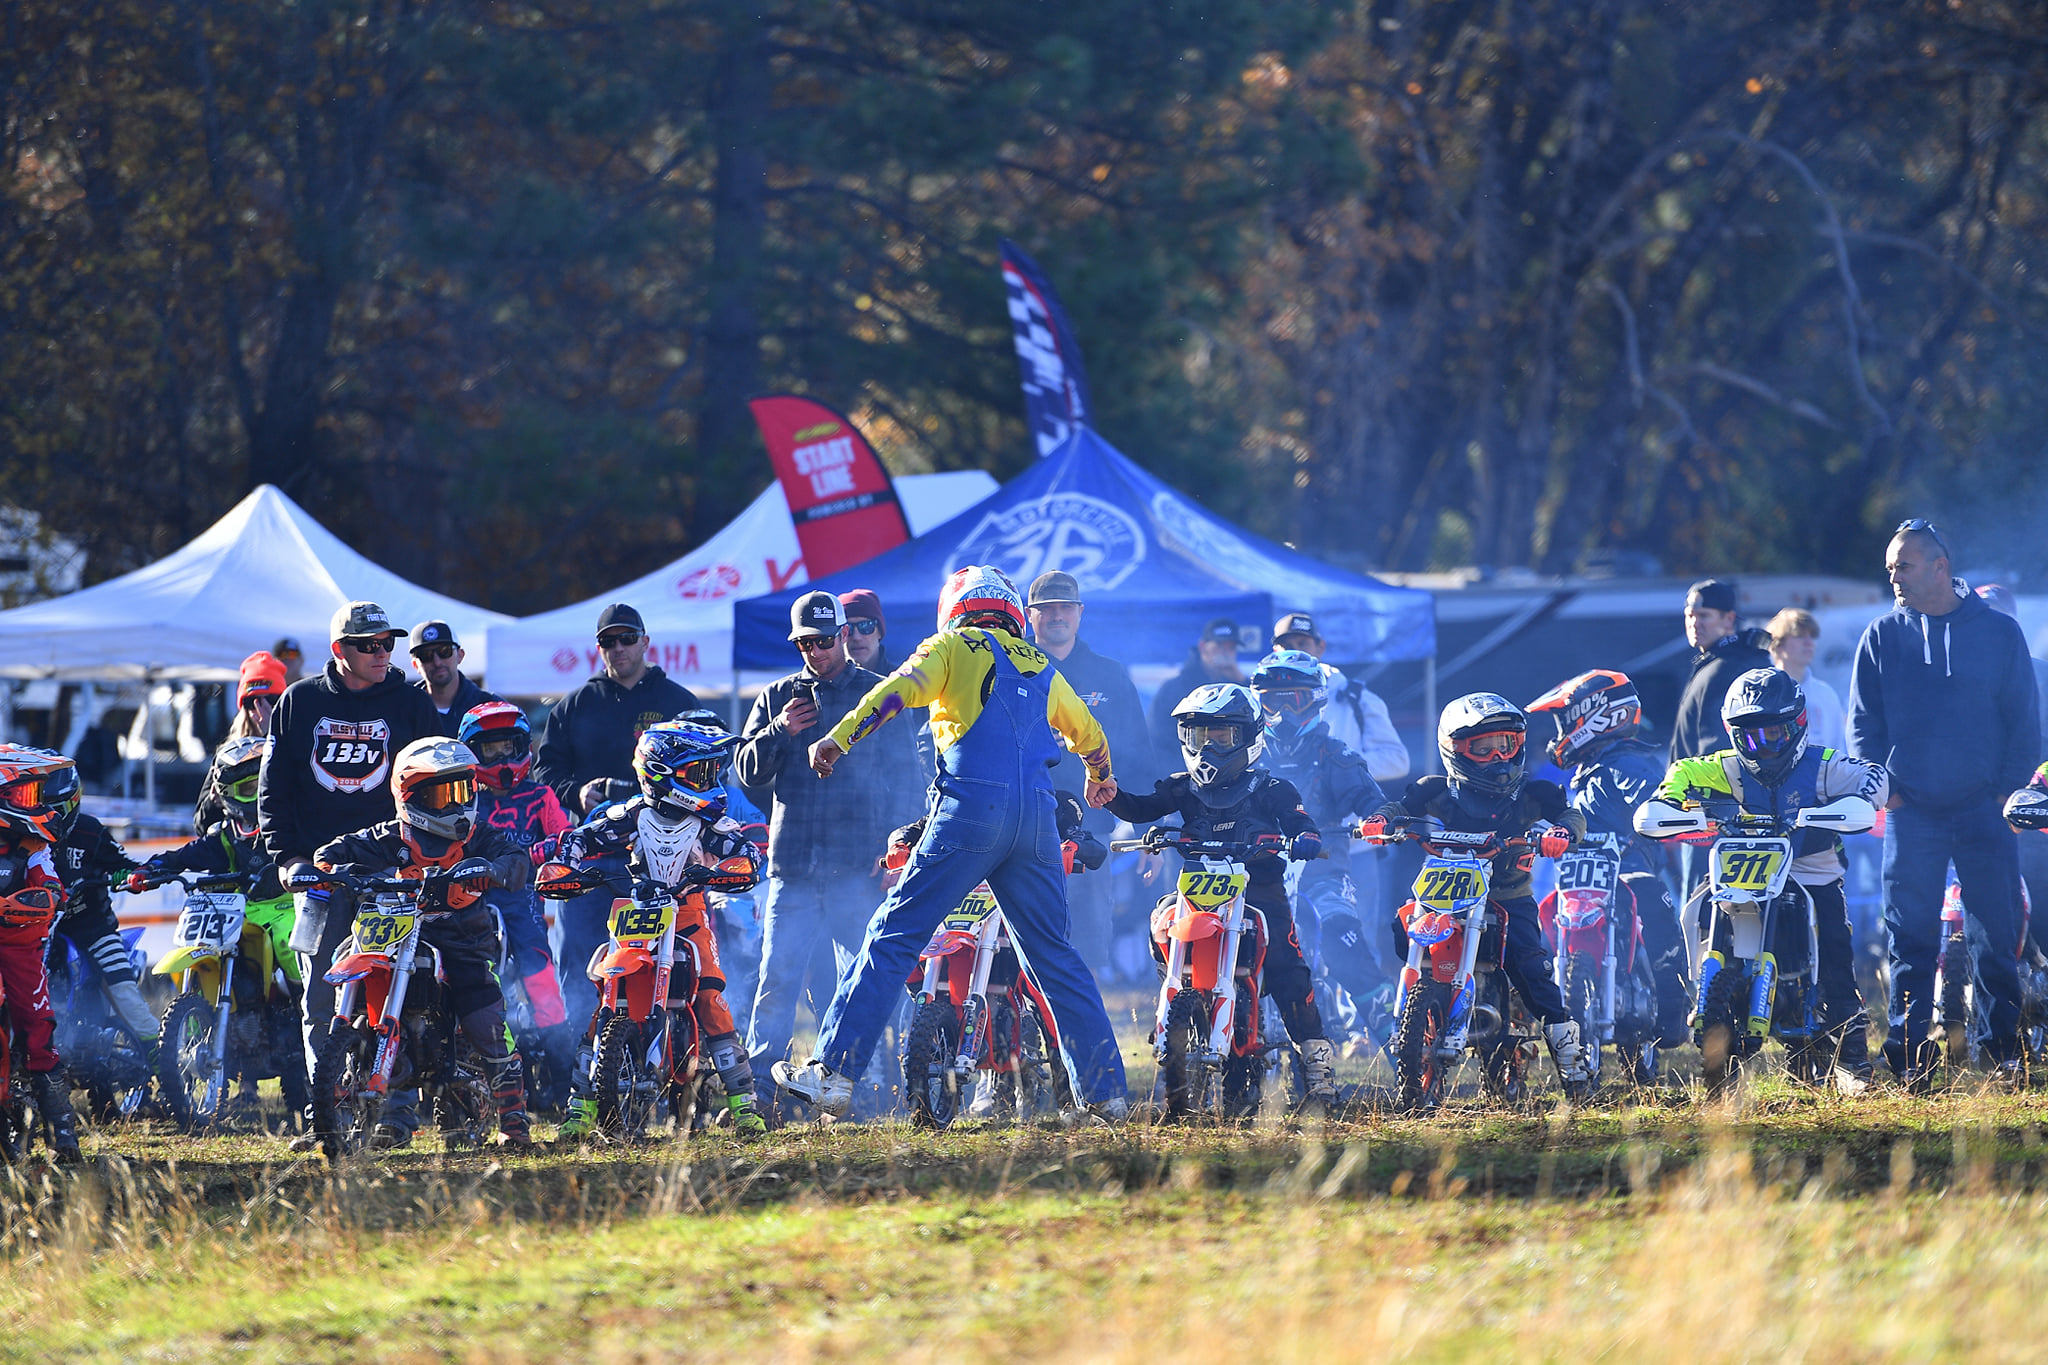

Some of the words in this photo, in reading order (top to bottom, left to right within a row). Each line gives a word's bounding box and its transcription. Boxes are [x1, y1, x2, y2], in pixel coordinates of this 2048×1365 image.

[792, 436, 856, 476] START
[810, 463, 857, 499] LINE
[585, 644, 701, 672] YAHA
[1565, 690, 1609, 725] 100%
[339, 778, 361, 786] 2021
[2011, 807, 2048, 816] ACERB
[1212, 821, 1236, 832] LEATT
[291, 875, 319, 883] CERBIS
[1559, 859, 1616, 890] 203
[707, 876, 751, 885] ACERBIS
[538, 882, 582, 891] ACERBIS
[3, 909, 49, 917] ACERBIS
[1757, 964, 1773, 1015] DUNLOP
